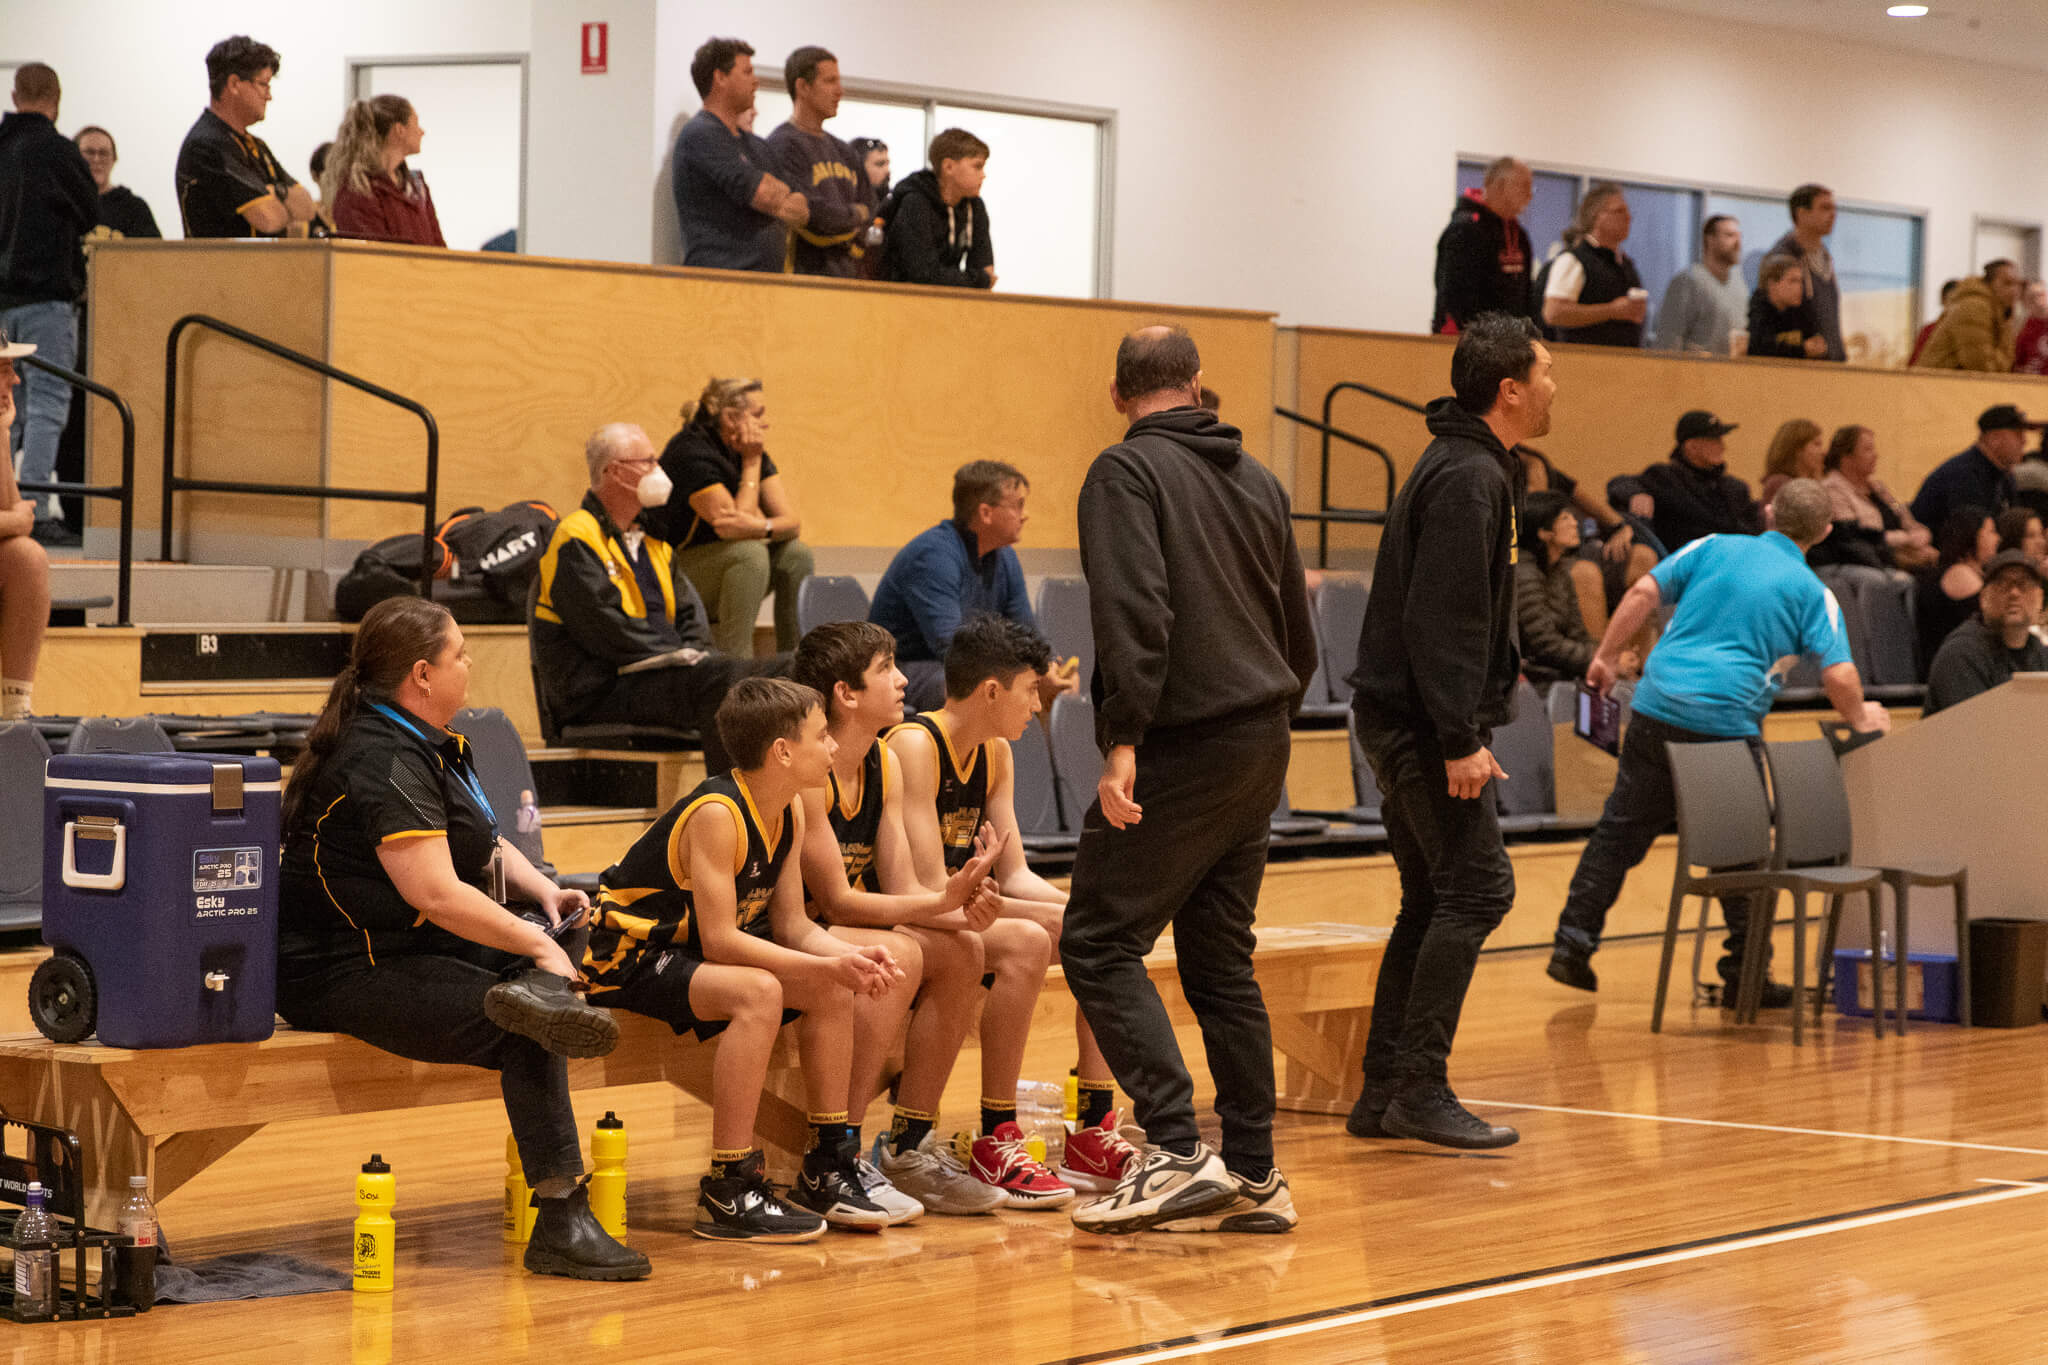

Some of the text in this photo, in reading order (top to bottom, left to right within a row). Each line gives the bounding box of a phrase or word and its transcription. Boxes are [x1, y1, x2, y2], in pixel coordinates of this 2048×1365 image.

[480, 531, 537, 570] HART
[201, 634, 218, 654] B3
[217, 869, 232, 878] 25
[196, 895, 225, 909] Esky
[196, 907, 258, 918] ARCTIC PRO 25
[4, 1179, 27, 1192] WORLD
